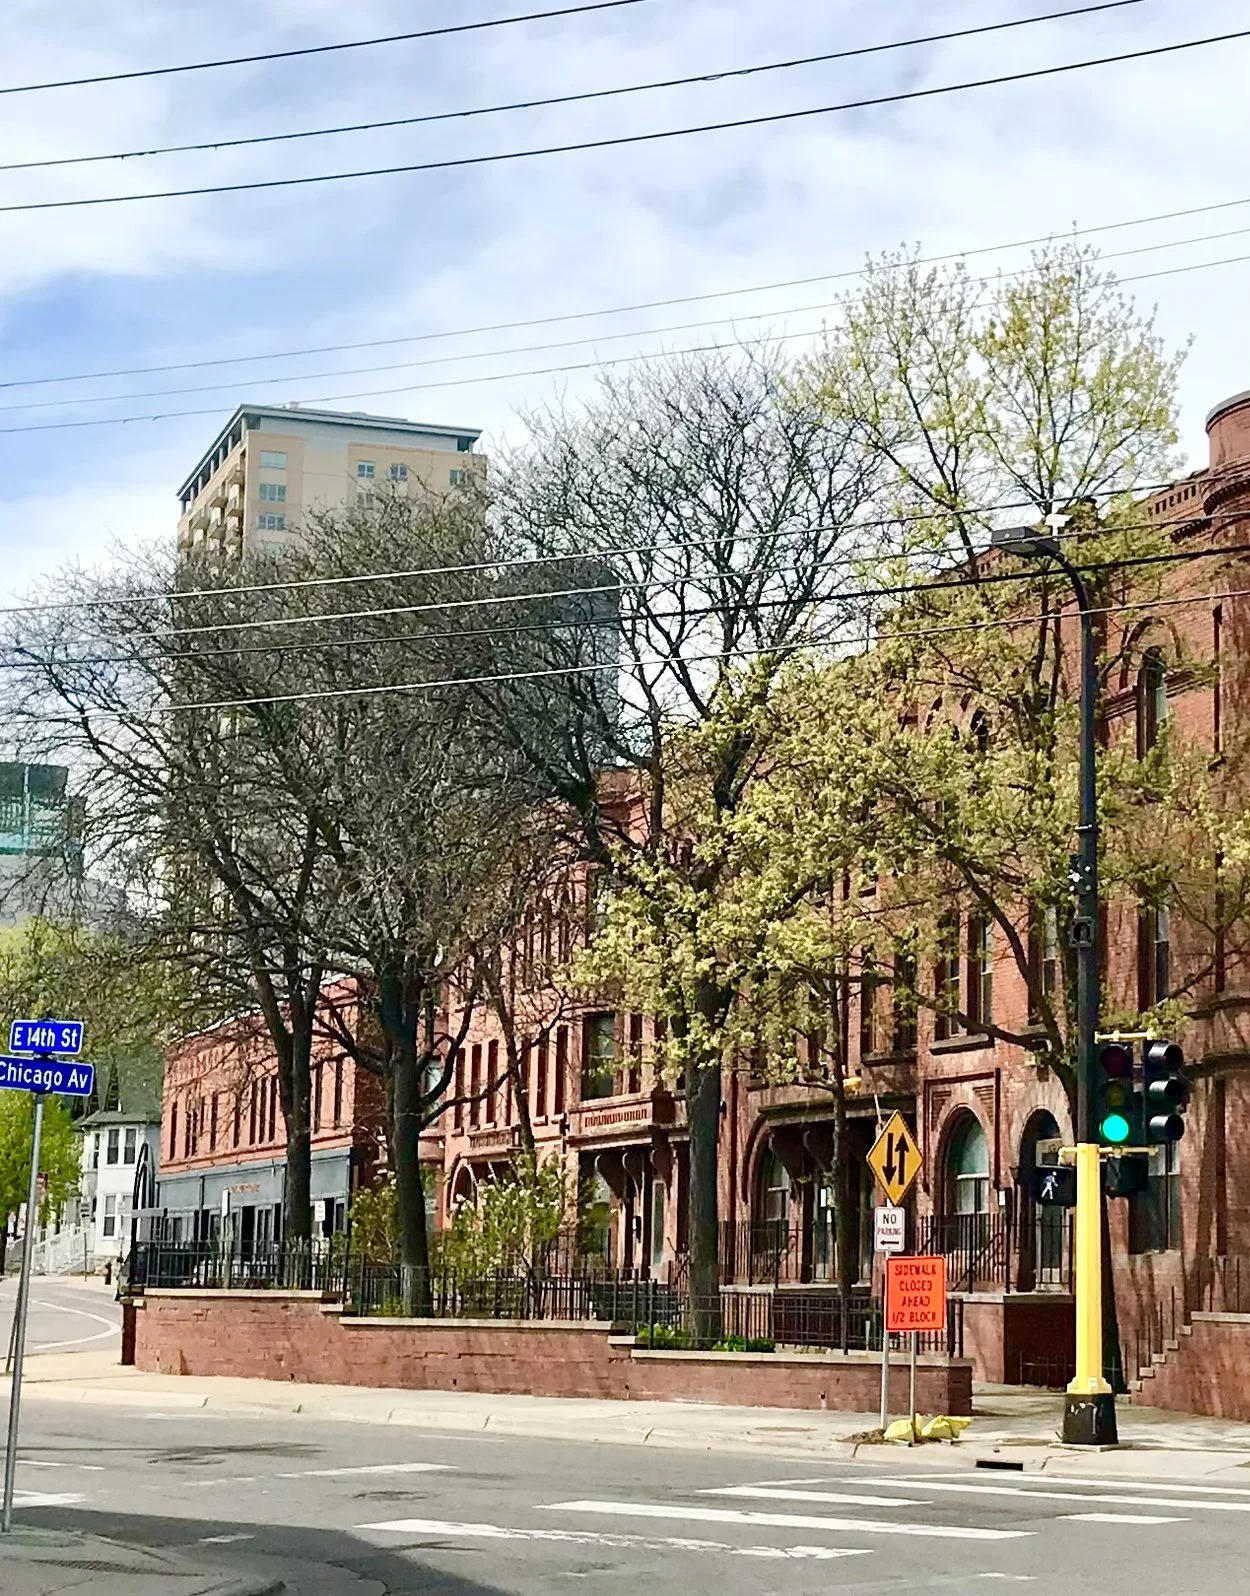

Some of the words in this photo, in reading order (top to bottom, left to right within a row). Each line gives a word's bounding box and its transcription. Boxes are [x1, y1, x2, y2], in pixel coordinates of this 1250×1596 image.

[13, 1026, 24, 1046] E
[26, 1026, 56, 1047] 14th
[60, 1027, 79, 1048] St
[0, 1060, 63, 1091] Chicago
[66, 1068, 89, 1089] Av
[882, 1213, 897, 1224] NO
[894, 1264, 937, 1276] SIDEWALK
[899, 1280, 933, 1291] CLOSED
[901, 1295, 931, 1307] AHEAD
[892, 1311, 905, 1324] 1/2
[909, 1311, 938, 1323] BLOCK
